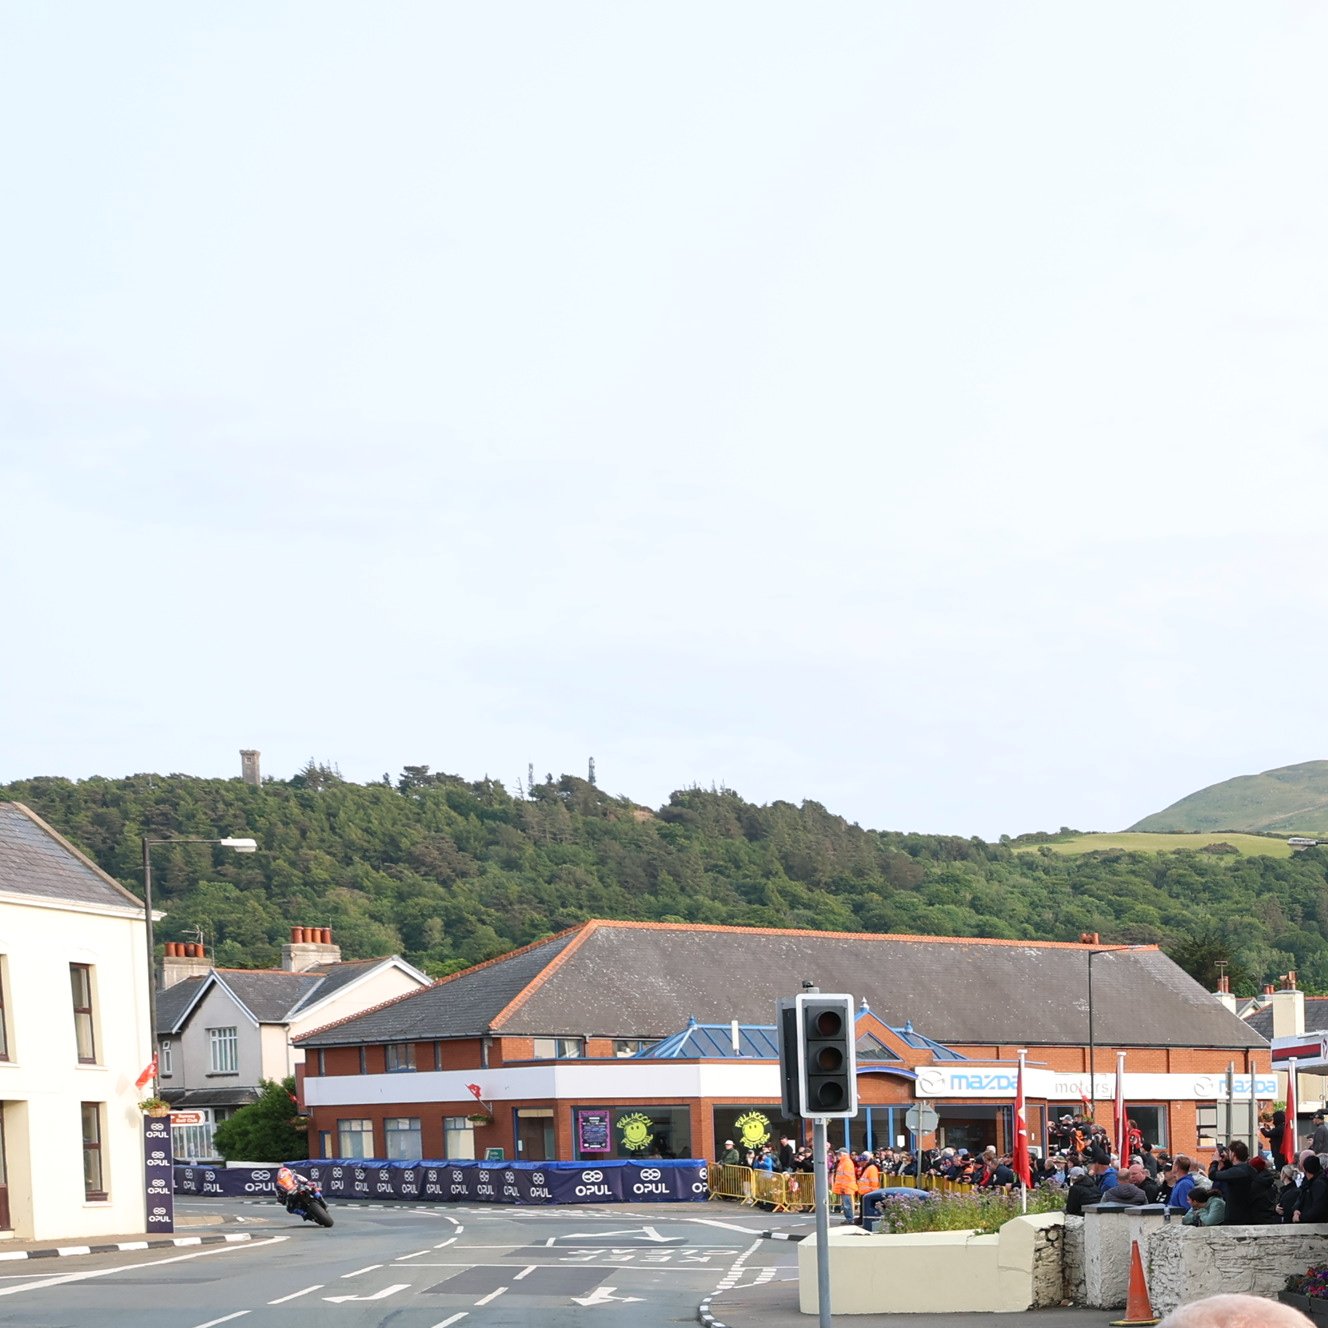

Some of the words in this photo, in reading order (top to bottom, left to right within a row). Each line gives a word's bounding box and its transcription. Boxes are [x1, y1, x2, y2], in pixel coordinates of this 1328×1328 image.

[530, 1186, 552, 1198] OPUL
[575, 1184, 612, 1196] OPUL
[633, 1183, 670, 1194] OPUL
